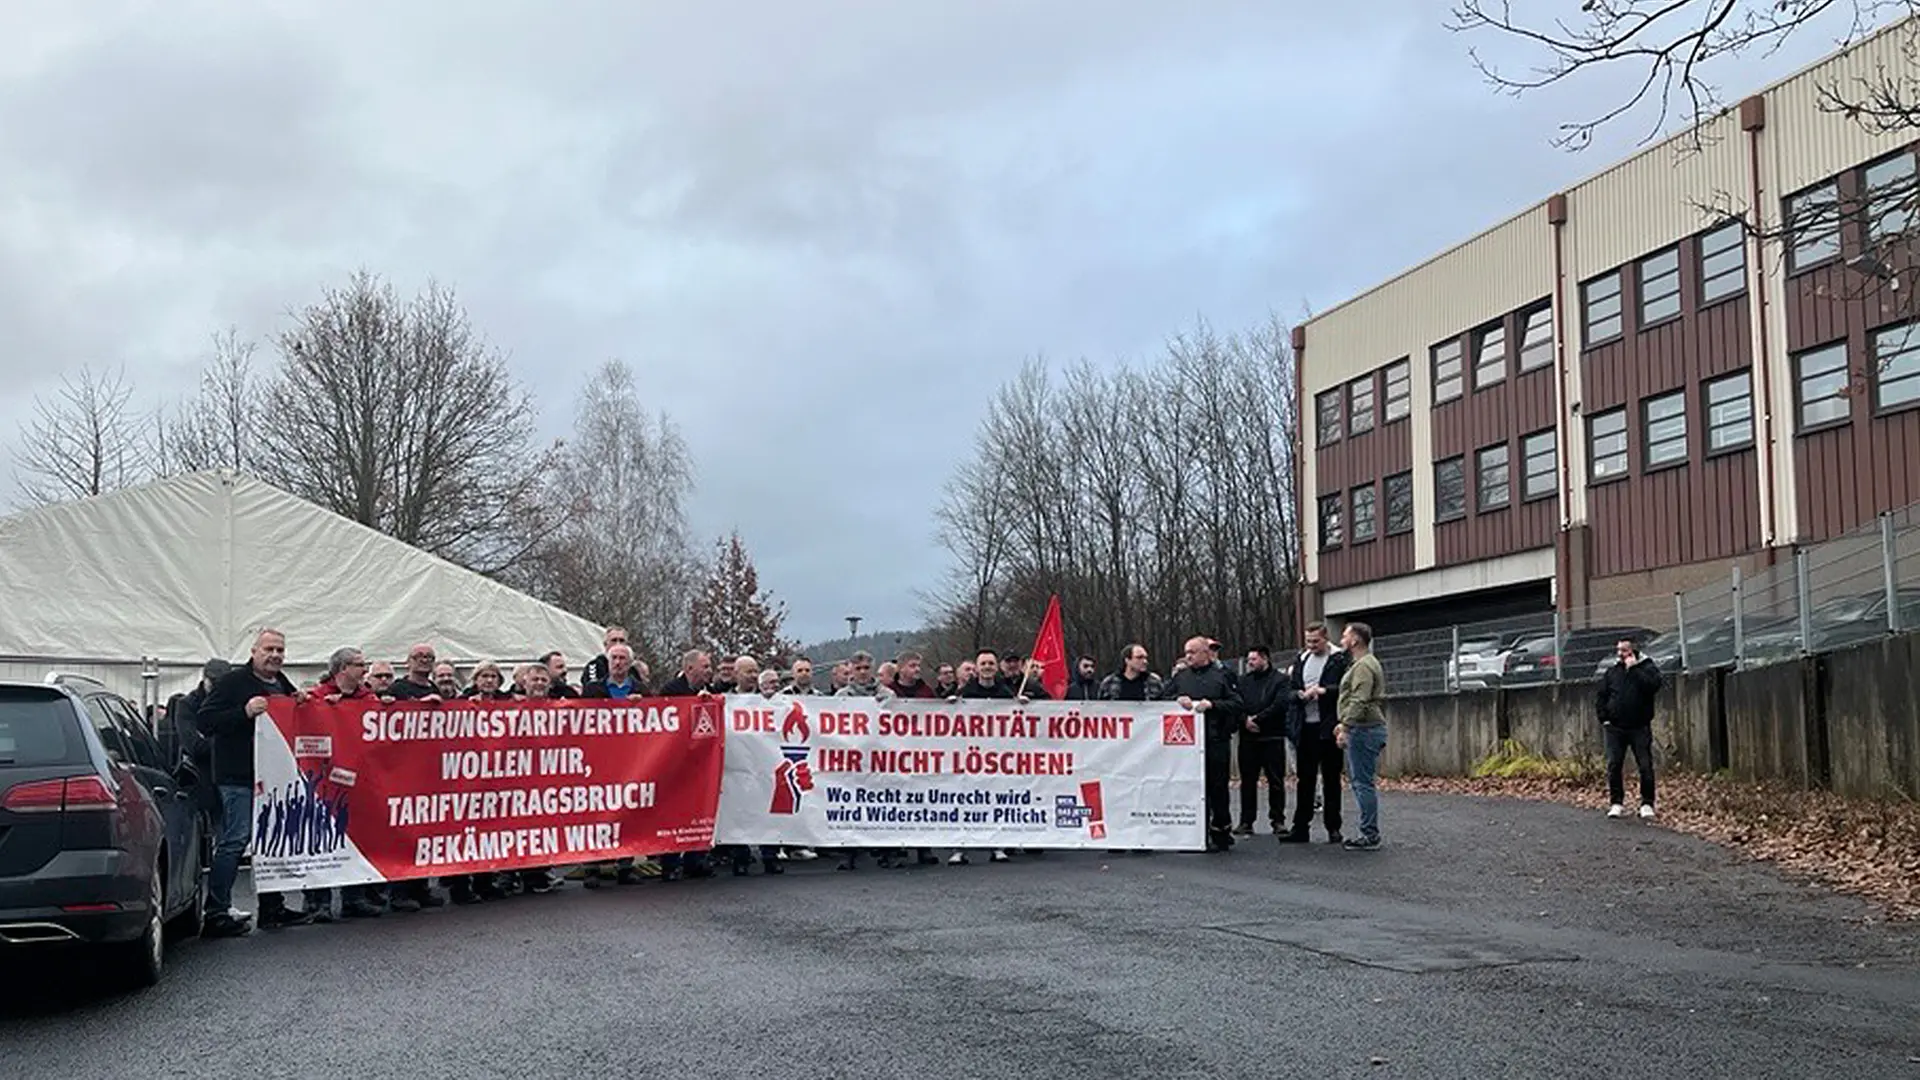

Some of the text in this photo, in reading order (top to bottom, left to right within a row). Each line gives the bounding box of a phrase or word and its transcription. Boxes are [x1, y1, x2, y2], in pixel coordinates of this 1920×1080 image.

[361, 706, 680, 742] SICHERUNGSTARIFVERTRAG
[733, 709, 1134, 739] DIE DER SOLIDARITÄT KÖNNT
[441, 748, 591, 780] WOLLEN WIR,
[818, 746, 1073, 776] IHR NICHT LÖSCHEN!
[388, 782, 656, 826] TARIFVERTRAGSBRUCH
[826, 787, 851, 803] Wo
[855, 787, 901, 804] Recht
[906, 791, 924, 804] zu
[928, 788, 991, 805] Unrecht
[995, 789, 1031, 805] wird
[826, 806, 1047, 824] wird Widerstand zur Pflicht
[415, 827, 562, 867] BEKÄMPFEN
[564, 823, 622, 851] WIR!
